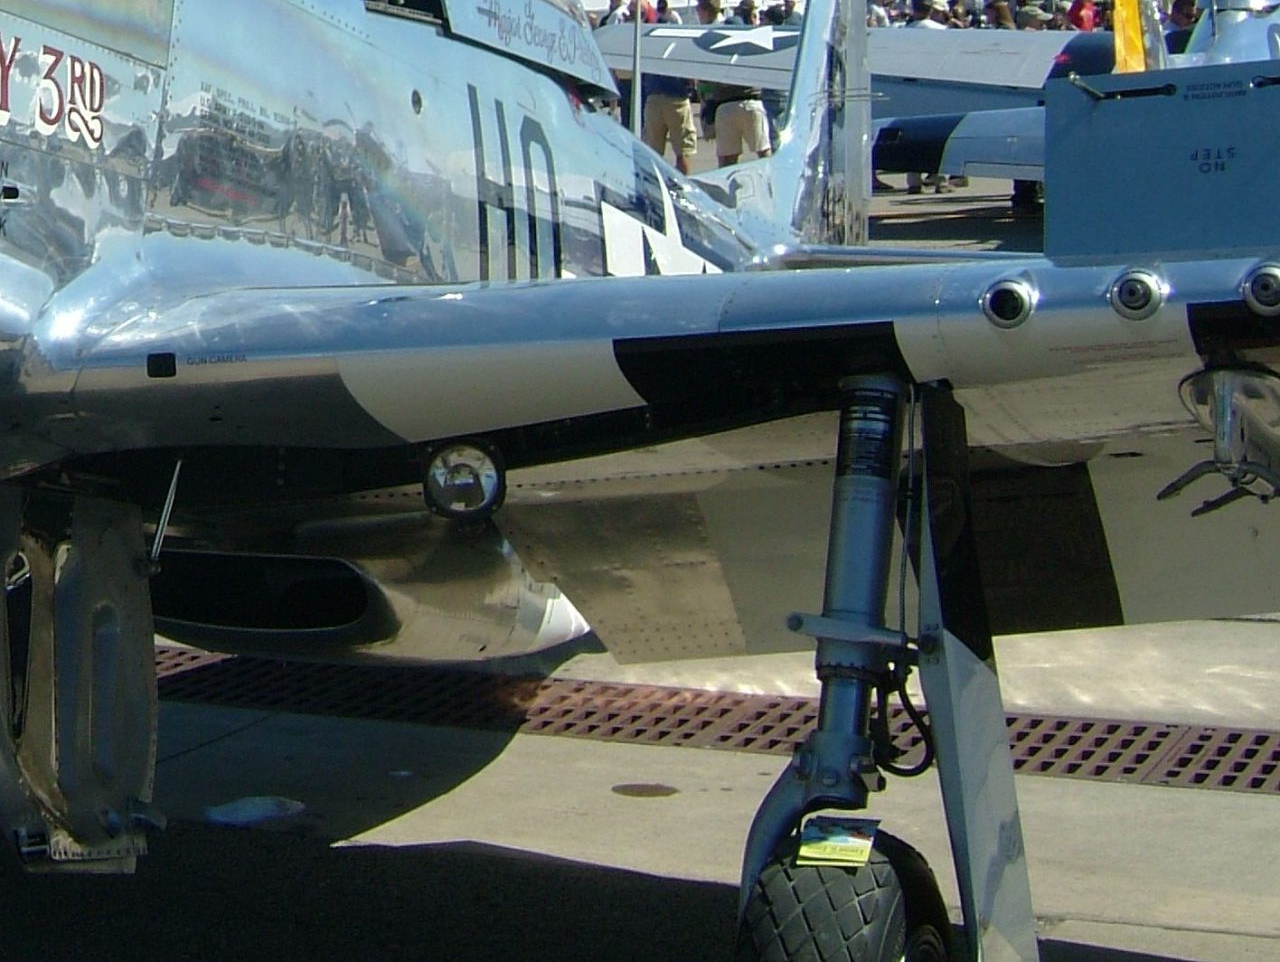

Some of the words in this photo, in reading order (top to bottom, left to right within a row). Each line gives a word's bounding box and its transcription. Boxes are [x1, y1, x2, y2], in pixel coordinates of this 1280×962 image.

[1190, 147, 1235, 161] STEP
[1199, 161, 1226, 174] NO
[186, 357, 207, 366] GUN
[209, 354, 248, 365] CAMERA
